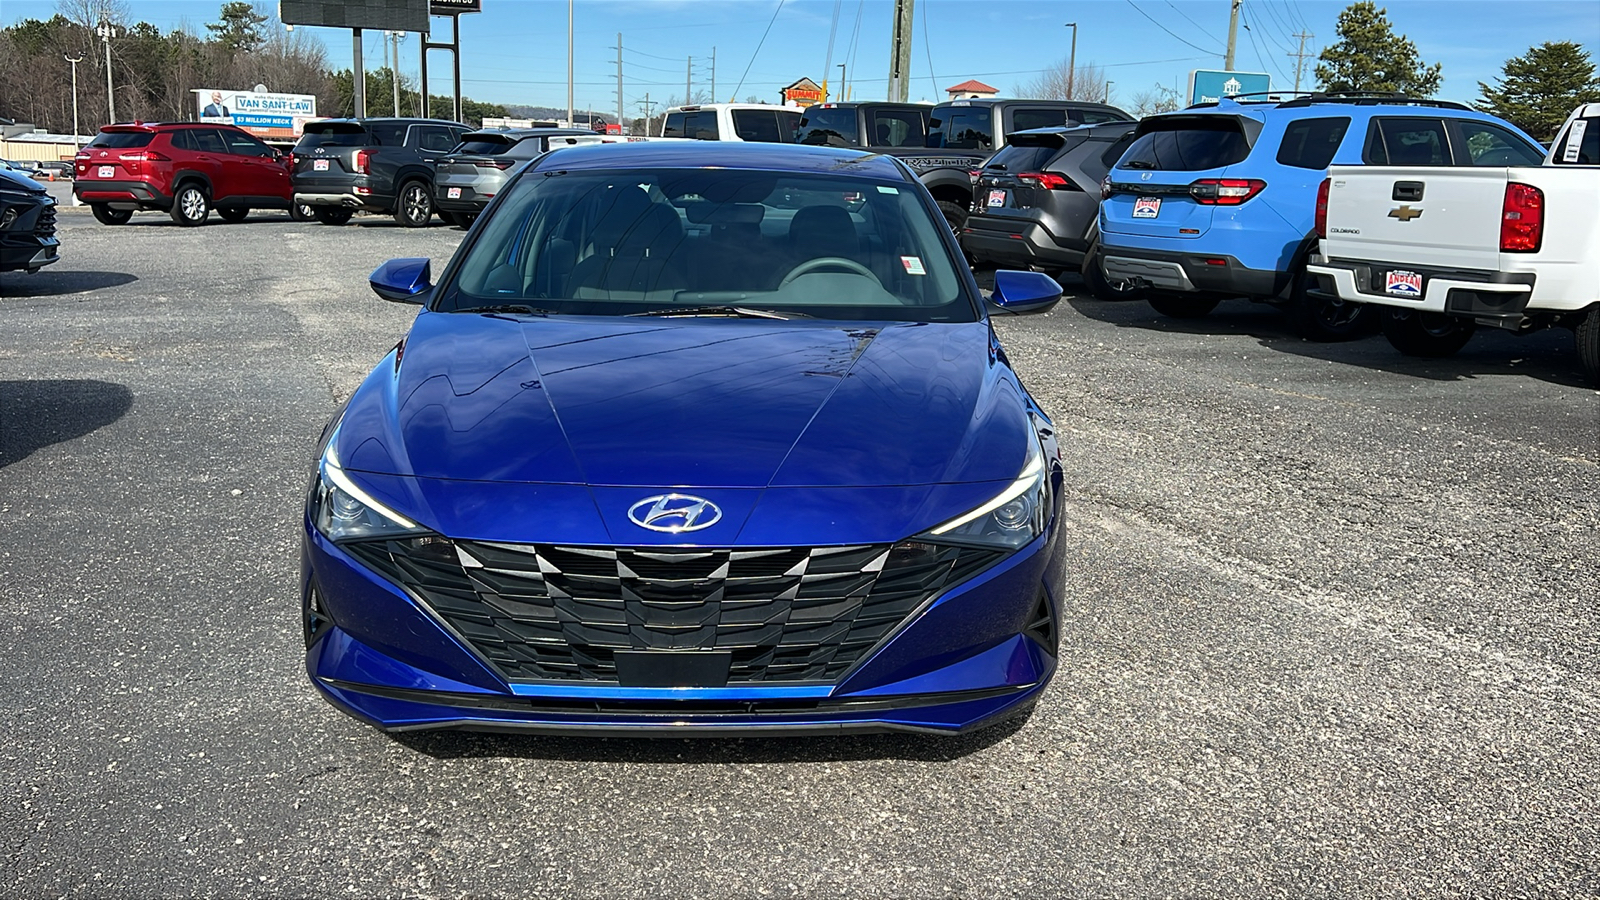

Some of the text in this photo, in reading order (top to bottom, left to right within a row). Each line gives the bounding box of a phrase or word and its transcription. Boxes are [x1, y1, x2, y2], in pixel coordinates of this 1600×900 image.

[787, 90, 821, 100] SUMMIT
[239, 99, 310, 110] VAN SANT LAW
[904, 159, 972, 168] RAPTOR
[1137, 200, 1158, 210] ANDEAN
[1388, 274, 1420, 290] ANDEAN
